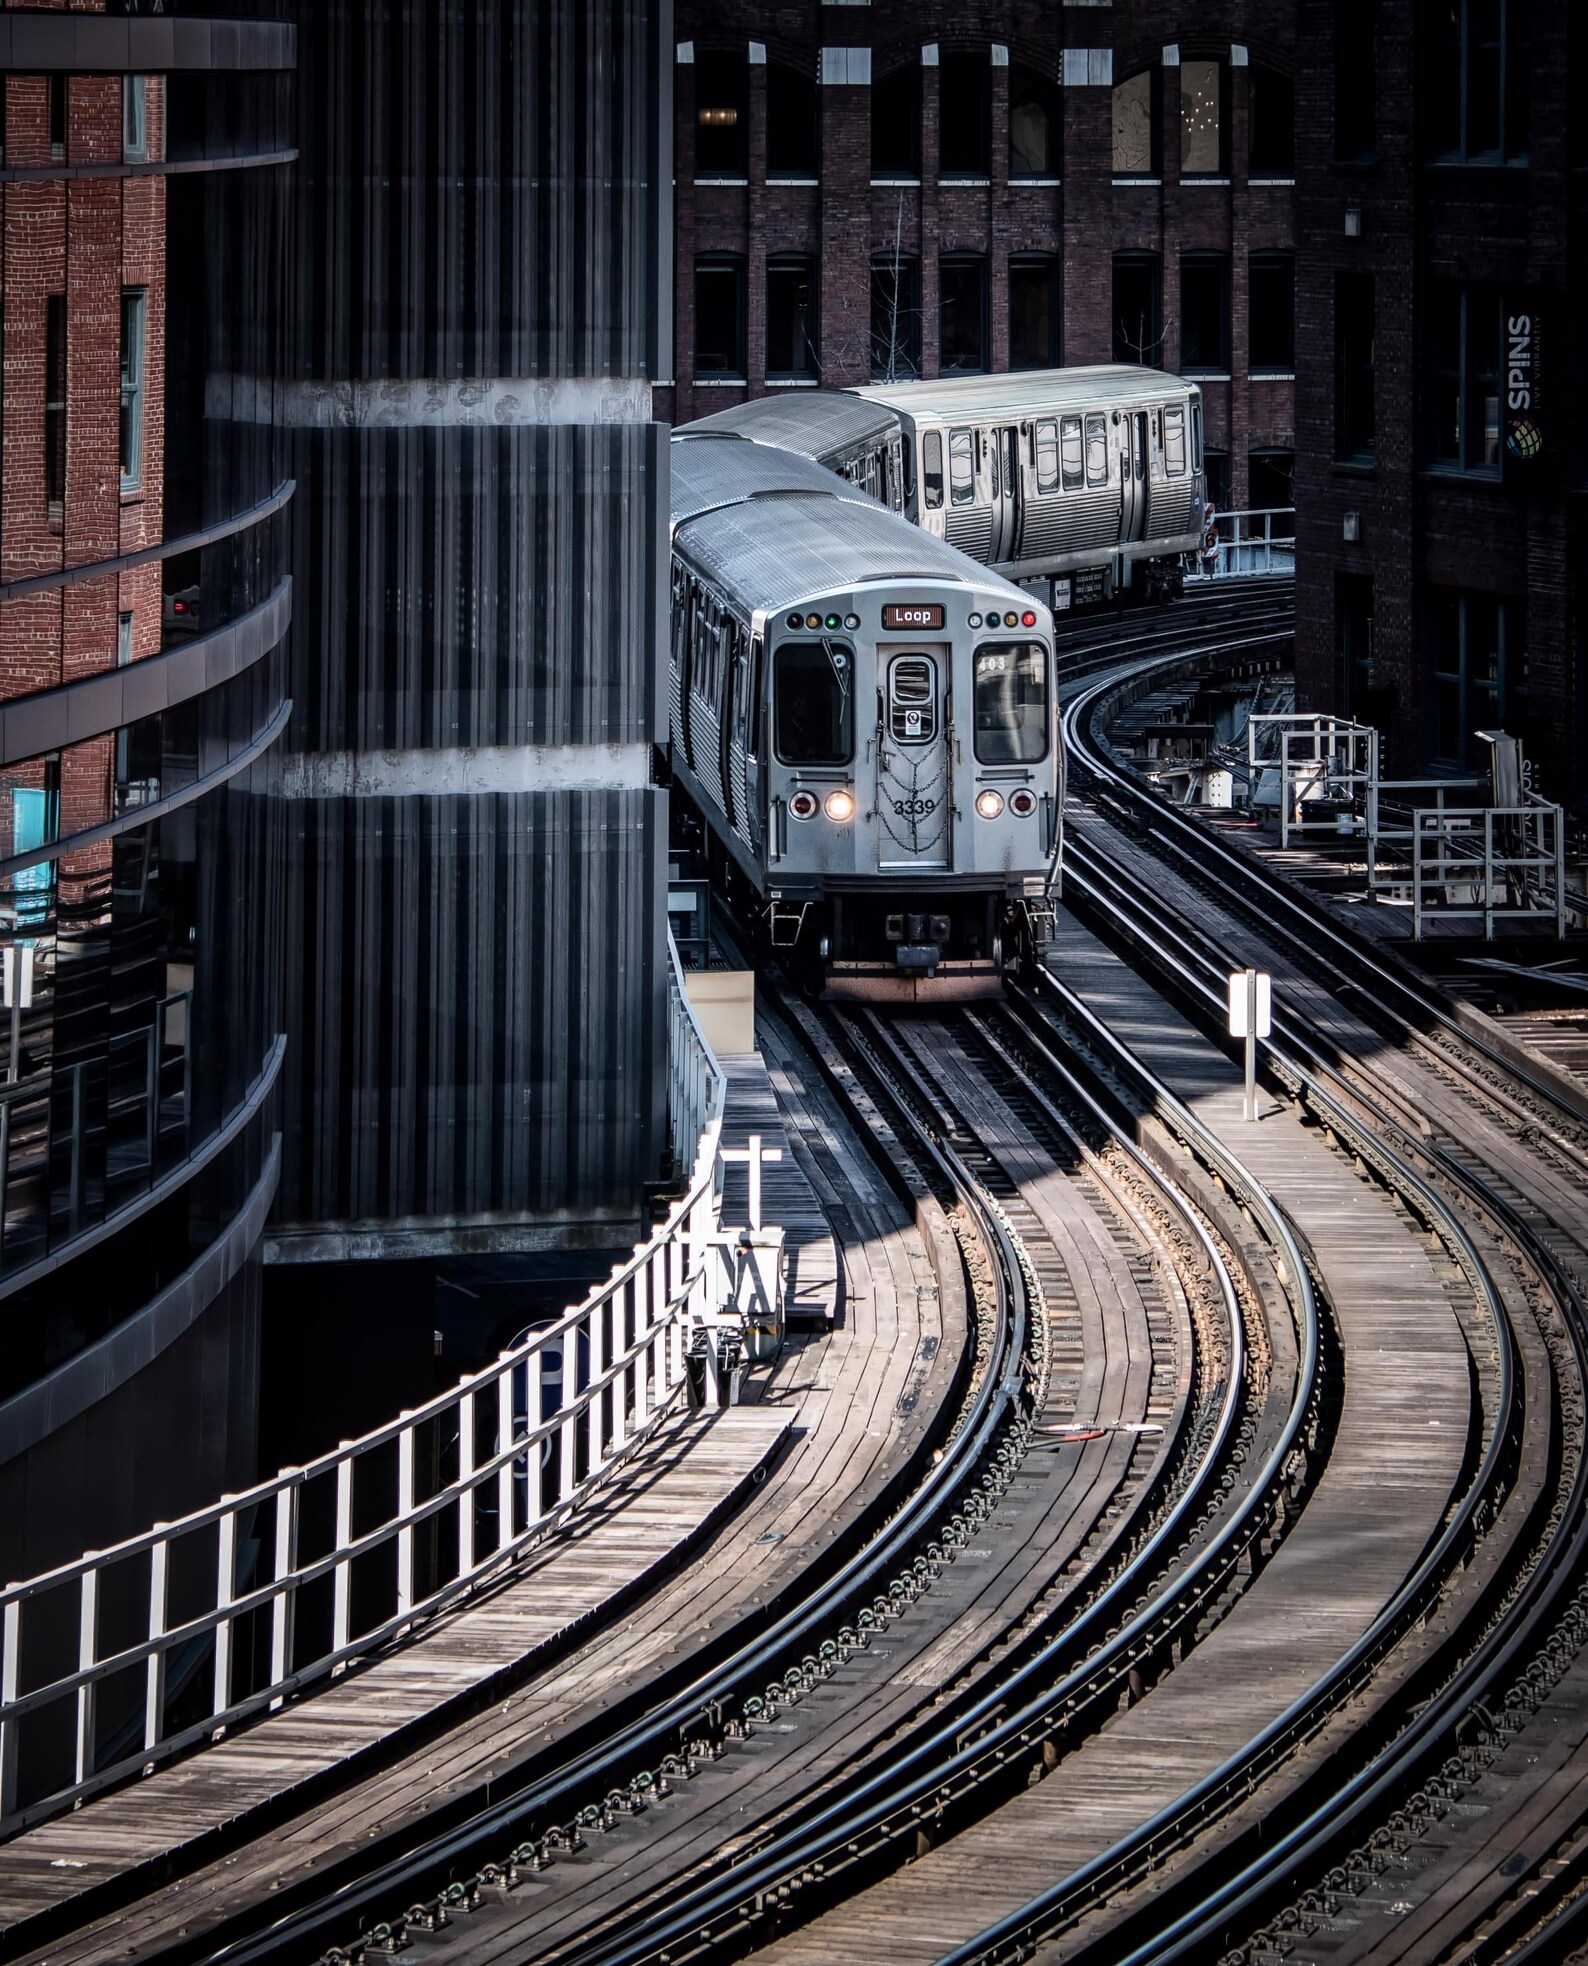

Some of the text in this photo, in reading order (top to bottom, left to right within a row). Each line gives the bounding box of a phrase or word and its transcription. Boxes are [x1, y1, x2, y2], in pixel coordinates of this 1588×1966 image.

[1507, 315, 1531, 410] SPINS
[895, 608, 931, 625] Loop
[893, 799, 935, 815] 3339
